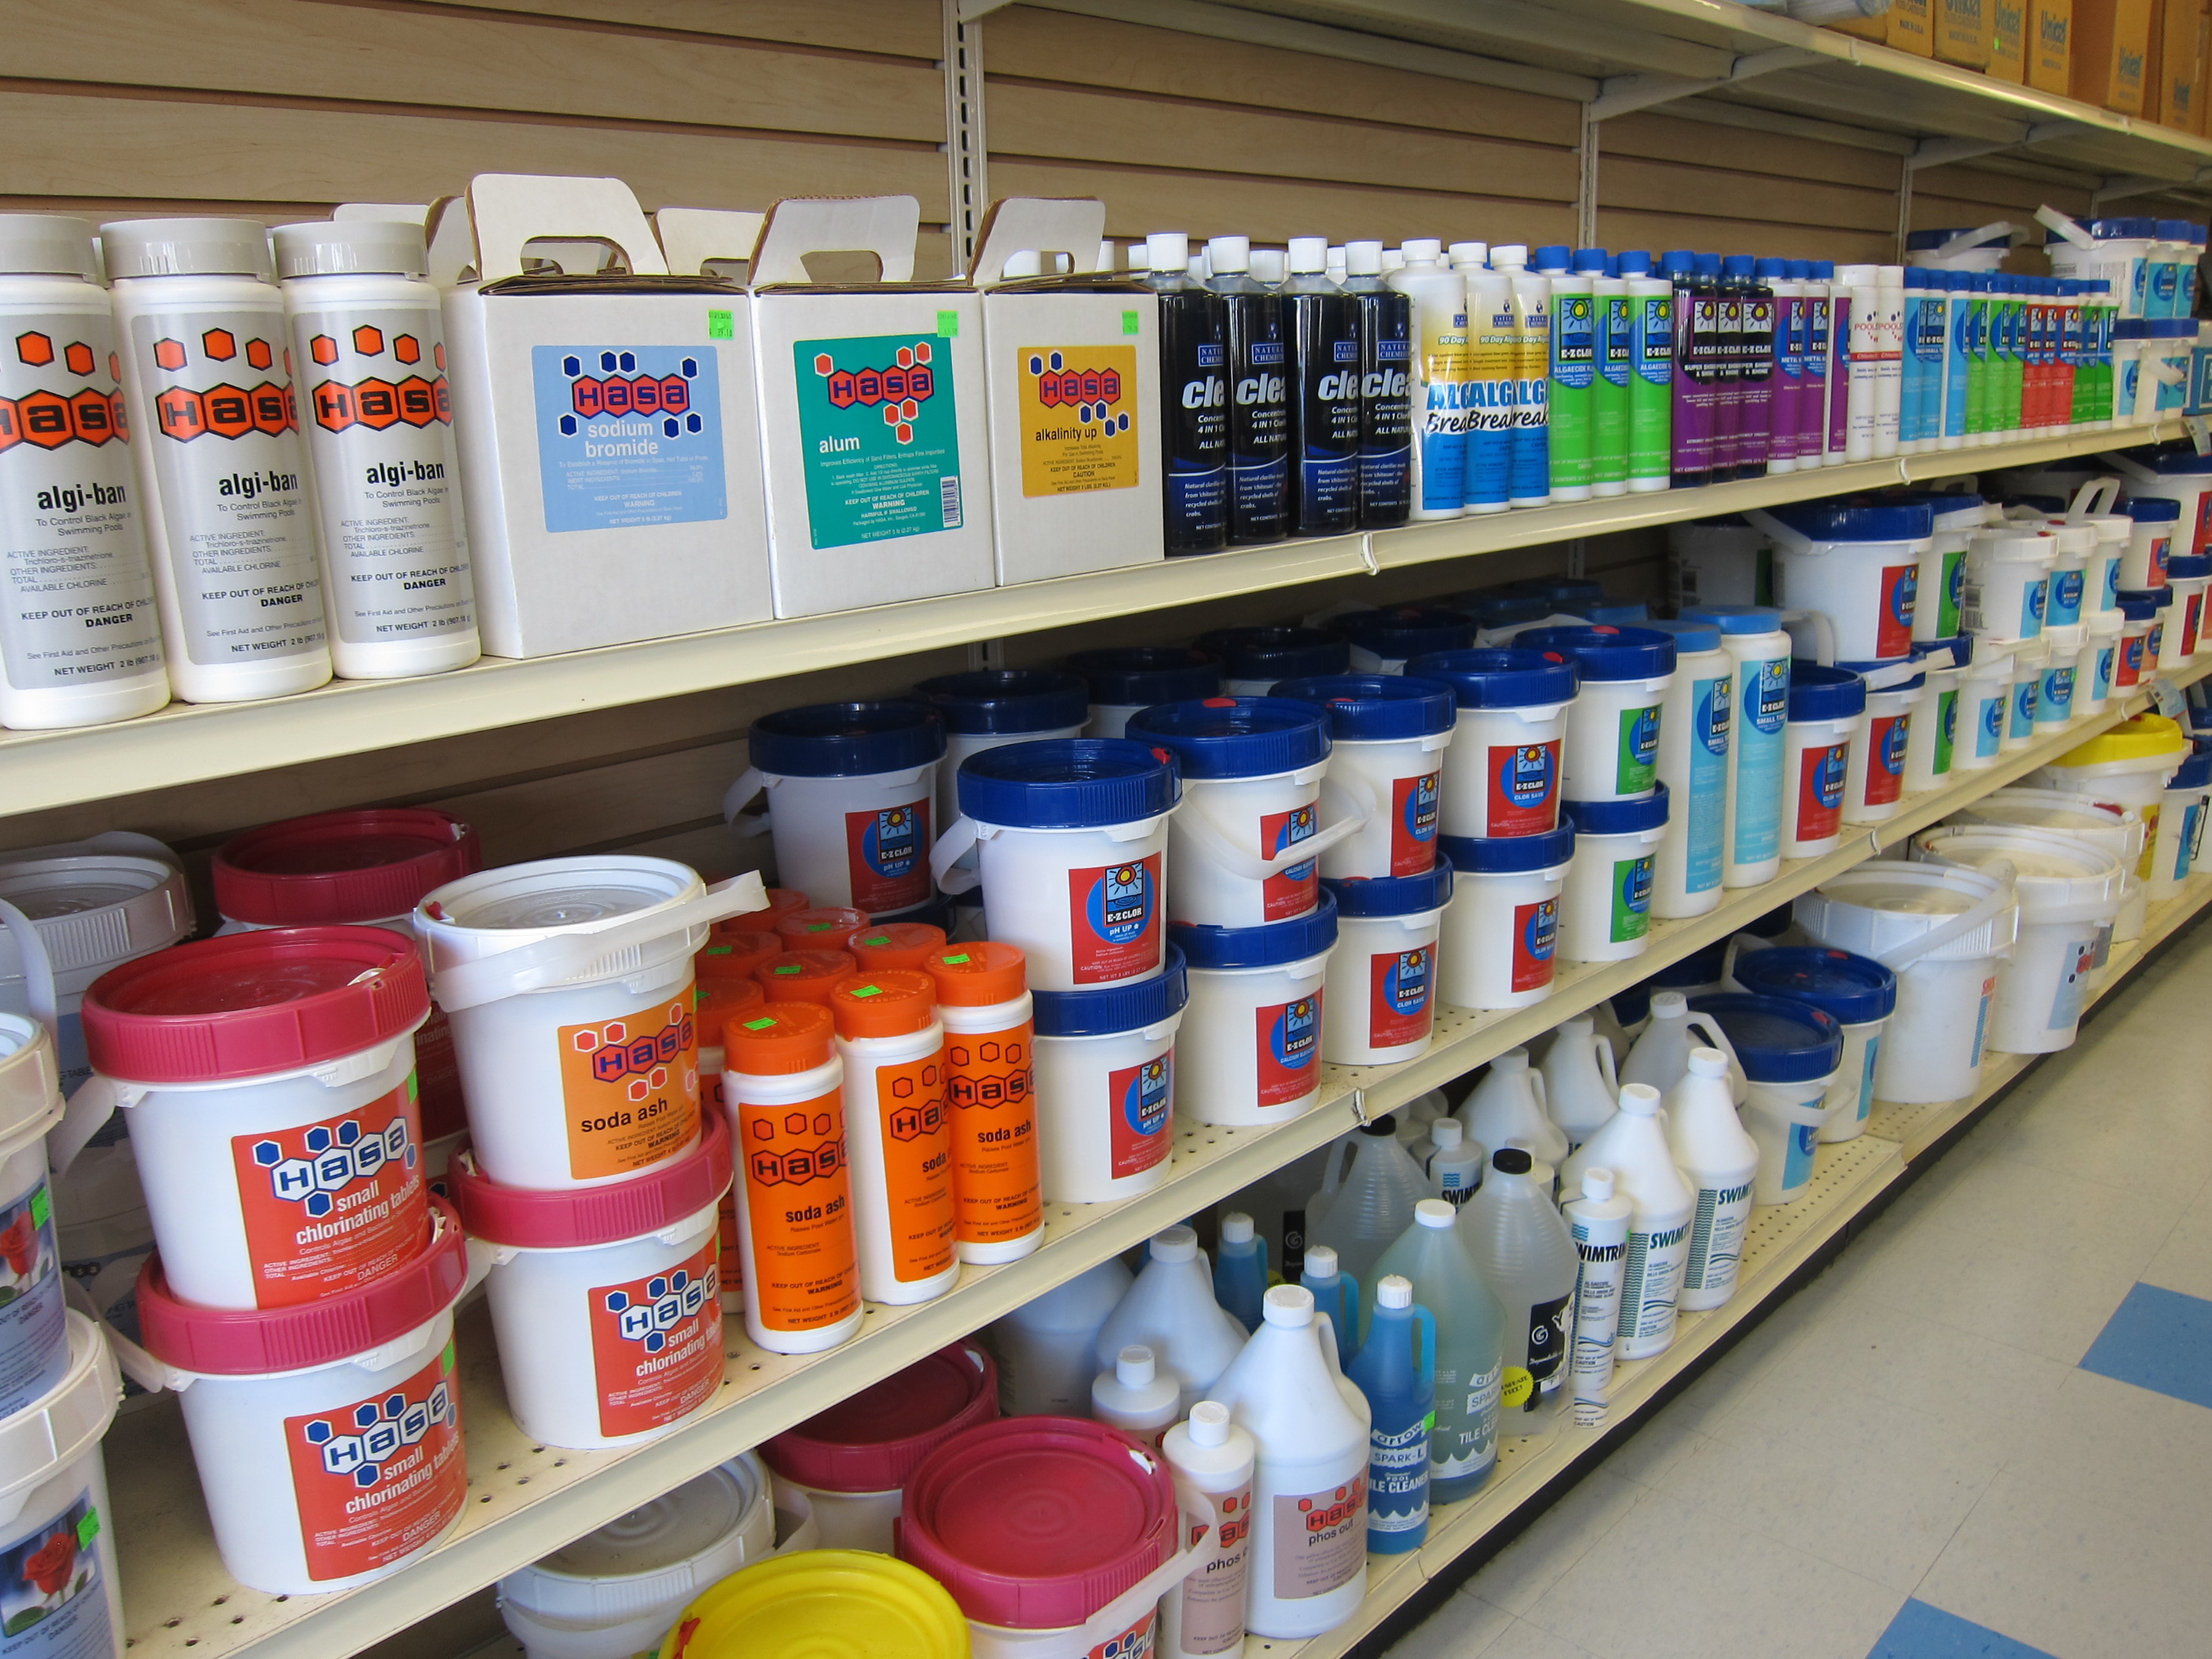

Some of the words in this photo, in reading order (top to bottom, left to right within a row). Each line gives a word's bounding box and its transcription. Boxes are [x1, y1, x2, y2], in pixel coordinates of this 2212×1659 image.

[1451, 336, 1466, 346] Day
[1490, 335, 1503, 345] Day
[1555, 364, 1586, 373] ALGAECIDE
[578, 385, 684, 406] Hasa
[833, 373, 930, 399] Hasa
[1044, 378, 1117, 397] Hasa
[1469, 379, 1513, 408] ALG
[320, 386, 452, 418] Hasa
[588, 420, 653, 438] sodium
[1036, 427, 1081, 441] alkalinity
[1085, 428, 1097, 440] up
[585, 439, 658, 458] bromide
[819, 435, 860, 453] alum
[366, 460, 445, 486] algi-ban
[219, 471, 298, 499] algi-ban
[376, 489, 404, 499] Control
[406, 488, 426, 496] Black
[38, 482, 126, 512] algi-ban
[383, 497, 421, 507] Swimming
[873, 500, 905, 510] WARNING
[237, 511, 277, 521] Swimming
[404, 578, 446, 590] DANGER
[410, 569, 438, 578] REACH
[261, 594, 303, 607] DANGER
[86, 613, 134, 628] DANGER
[395, 621, 428, 632] WEIGHT
[881, 850, 894, 860] E-Z
[1108, 913, 1121, 923] E-Z
[1122, 907, 1142, 920] CLOR
[1109, 925, 1120, 936] pH
[599, 1021, 691, 1073] Hasa
[581, 1111, 632, 1132] soda
[638, 1098, 668, 1121] ash
[1141, 1107, 1152, 1117] E-Z
[978, 1127, 1011, 1143] soda
[1014, 1119, 1031, 1137] ash
[280, 1125, 405, 1192] Hasa
[922, 1152, 946, 1174] soda
[336, 1180, 379, 1212] small
[996, 1198, 1027, 1210] WARNING
[786, 1206, 822, 1223] soda
[826, 1195, 844, 1215] ash
[296, 1199, 389, 1245] chlorinating
[357, 1254, 398, 1281] DANGER
[808, 1280, 843, 1295] WARNING
[625, 1269, 716, 1333] Hasa
[668, 1319, 699, 1347] small
[635, 1337, 705, 1377] chlorinating
[330, 1387, 447, 1467] Hasa
[1378, 1419, 1423, 1445] arrow
[1459, 1427, 1479, 1445] TILE
[383, 1445, 423, 1481] small
[1375, 1446, 1424, 1463] SPARK-L
[346, 1462, 432, 1514] chlorinating
[1388, 1470, 1429, 1494] CLEANER
[401, 1510, 441, 1542] DANGER
[1309, 1526, 1337, 1547] phos
[1339, 1518, 1354, 1535] out
[1207, 1553, 1241, 1574] phos
